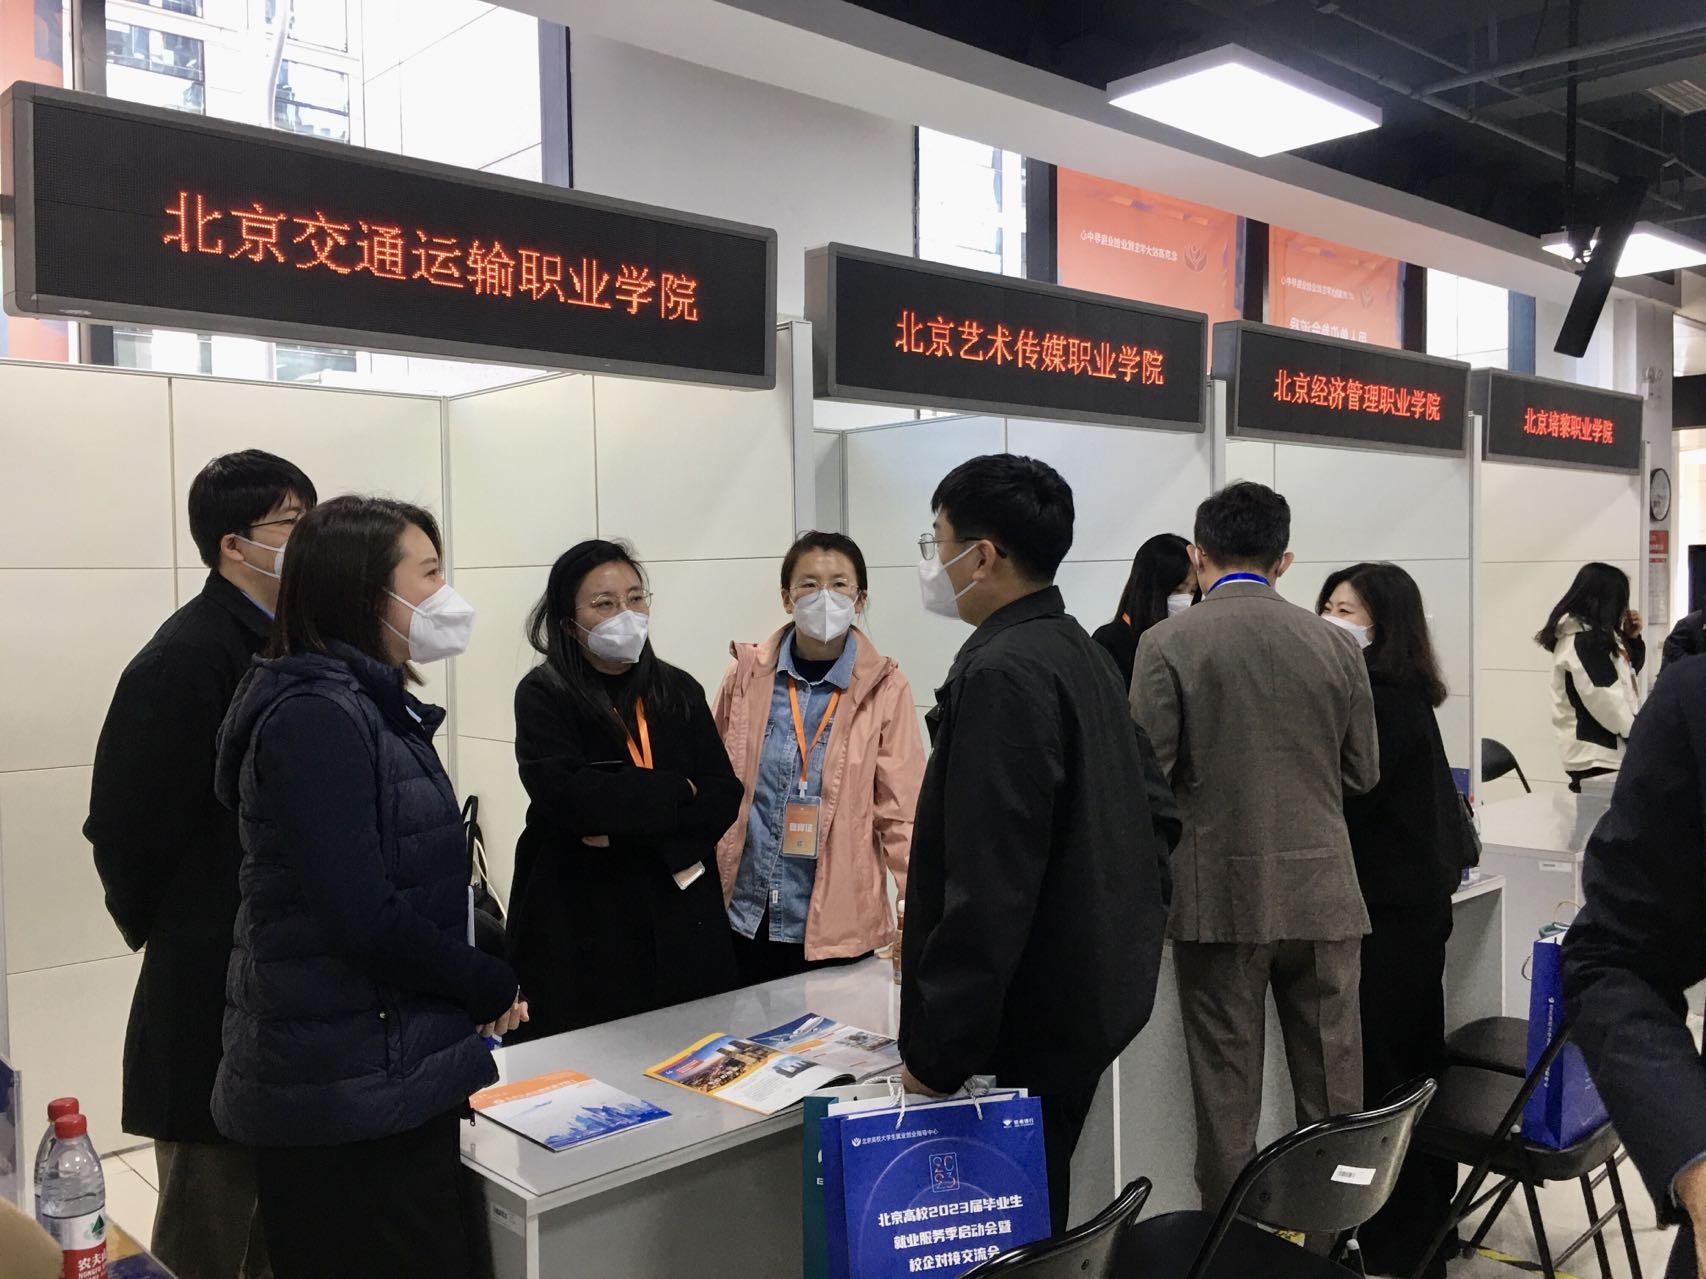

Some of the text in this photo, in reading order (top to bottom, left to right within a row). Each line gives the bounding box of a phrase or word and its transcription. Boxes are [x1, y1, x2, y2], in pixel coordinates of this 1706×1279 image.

[163, 191, 698, 322] 北京交通运输职业学院
[895, 310, 1165, 386] 北京艺术传媒职业学院
[1273, 368, 1441, 421] 北京经济管理职业学院
[1524, 407, 1614, 444] 北京培黎职业学院
[877, 1194, 1024, 1228] 北京高校2023届毕业生
[893, 1219, 1013, 1250] 就业服务季启动会暨
[909, 1245, 1001, 1273] 校企对接交流会
